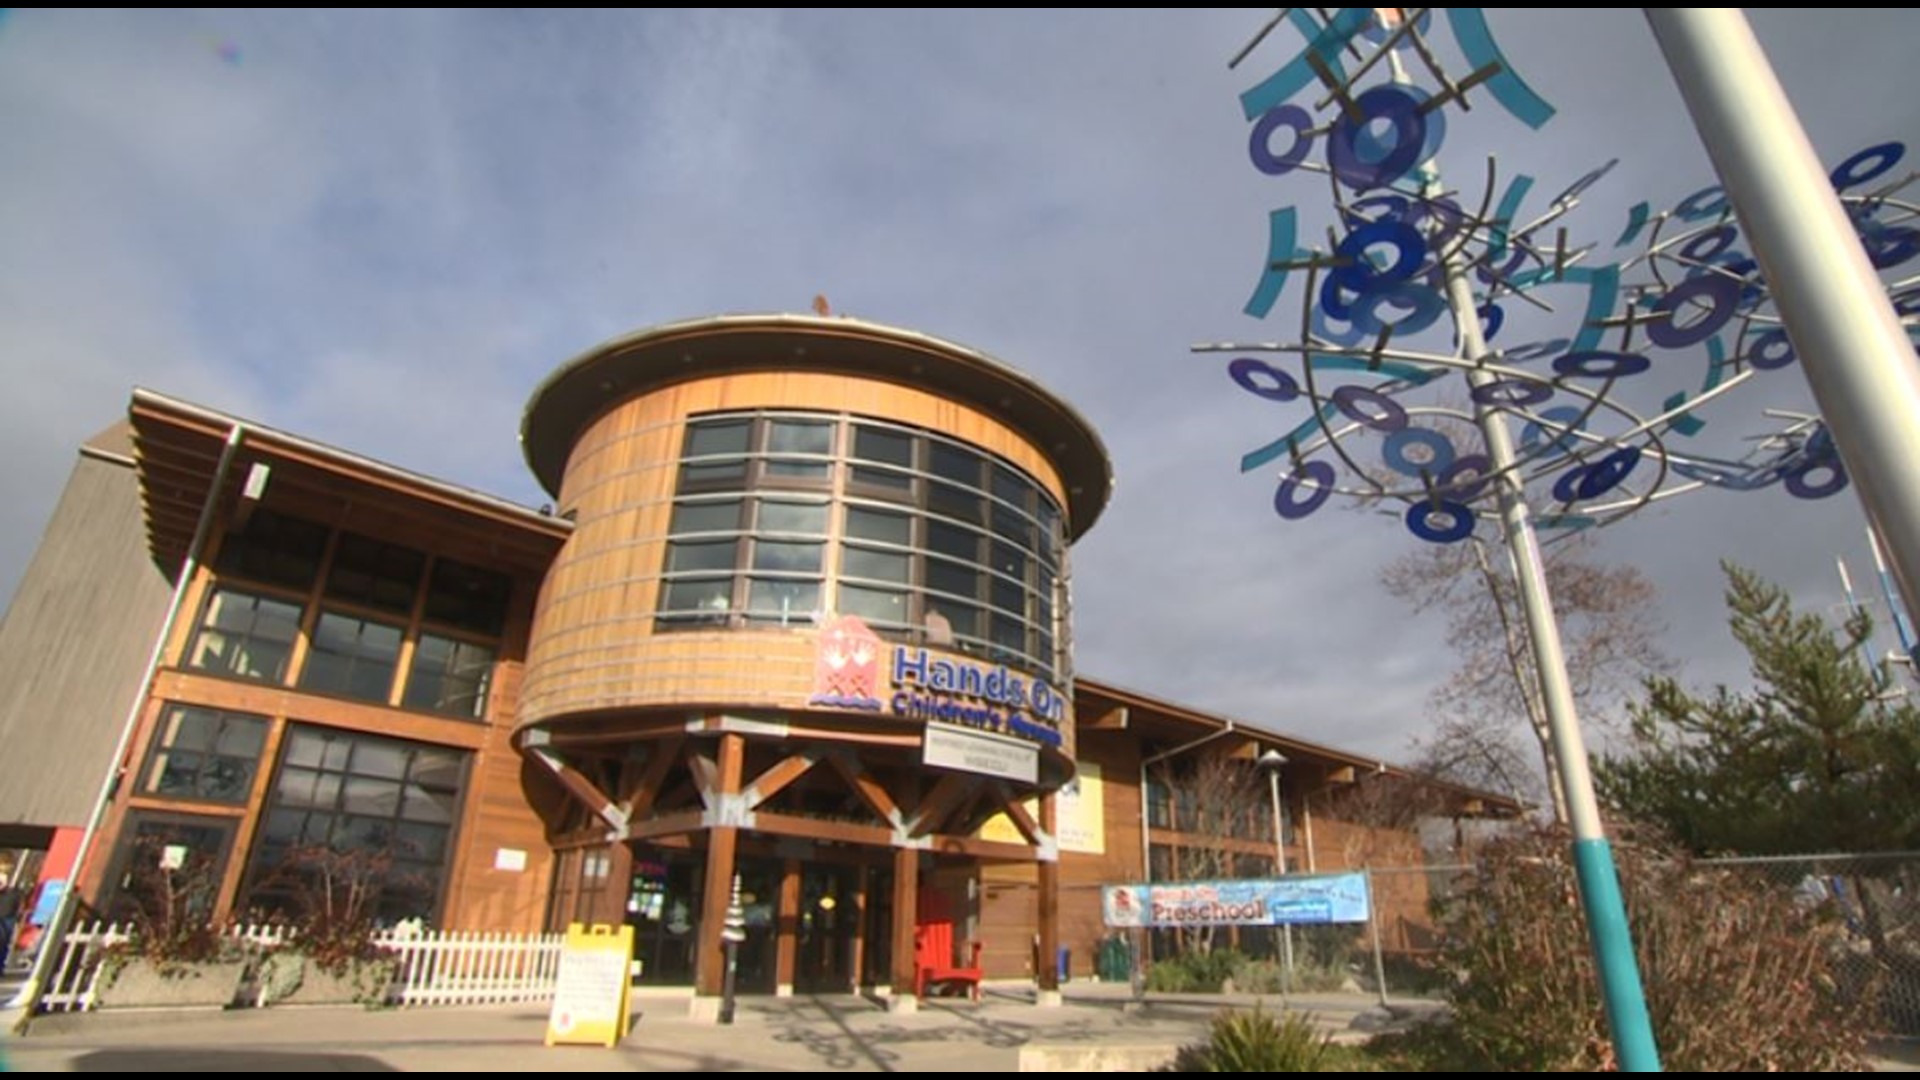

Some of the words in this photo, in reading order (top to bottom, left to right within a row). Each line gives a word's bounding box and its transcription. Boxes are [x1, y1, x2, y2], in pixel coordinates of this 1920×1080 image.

[893, 645, 1024, 706] Hands
[1029, 679, 1064, 721] On
[1151, 900, 1264, 921] Preschool
